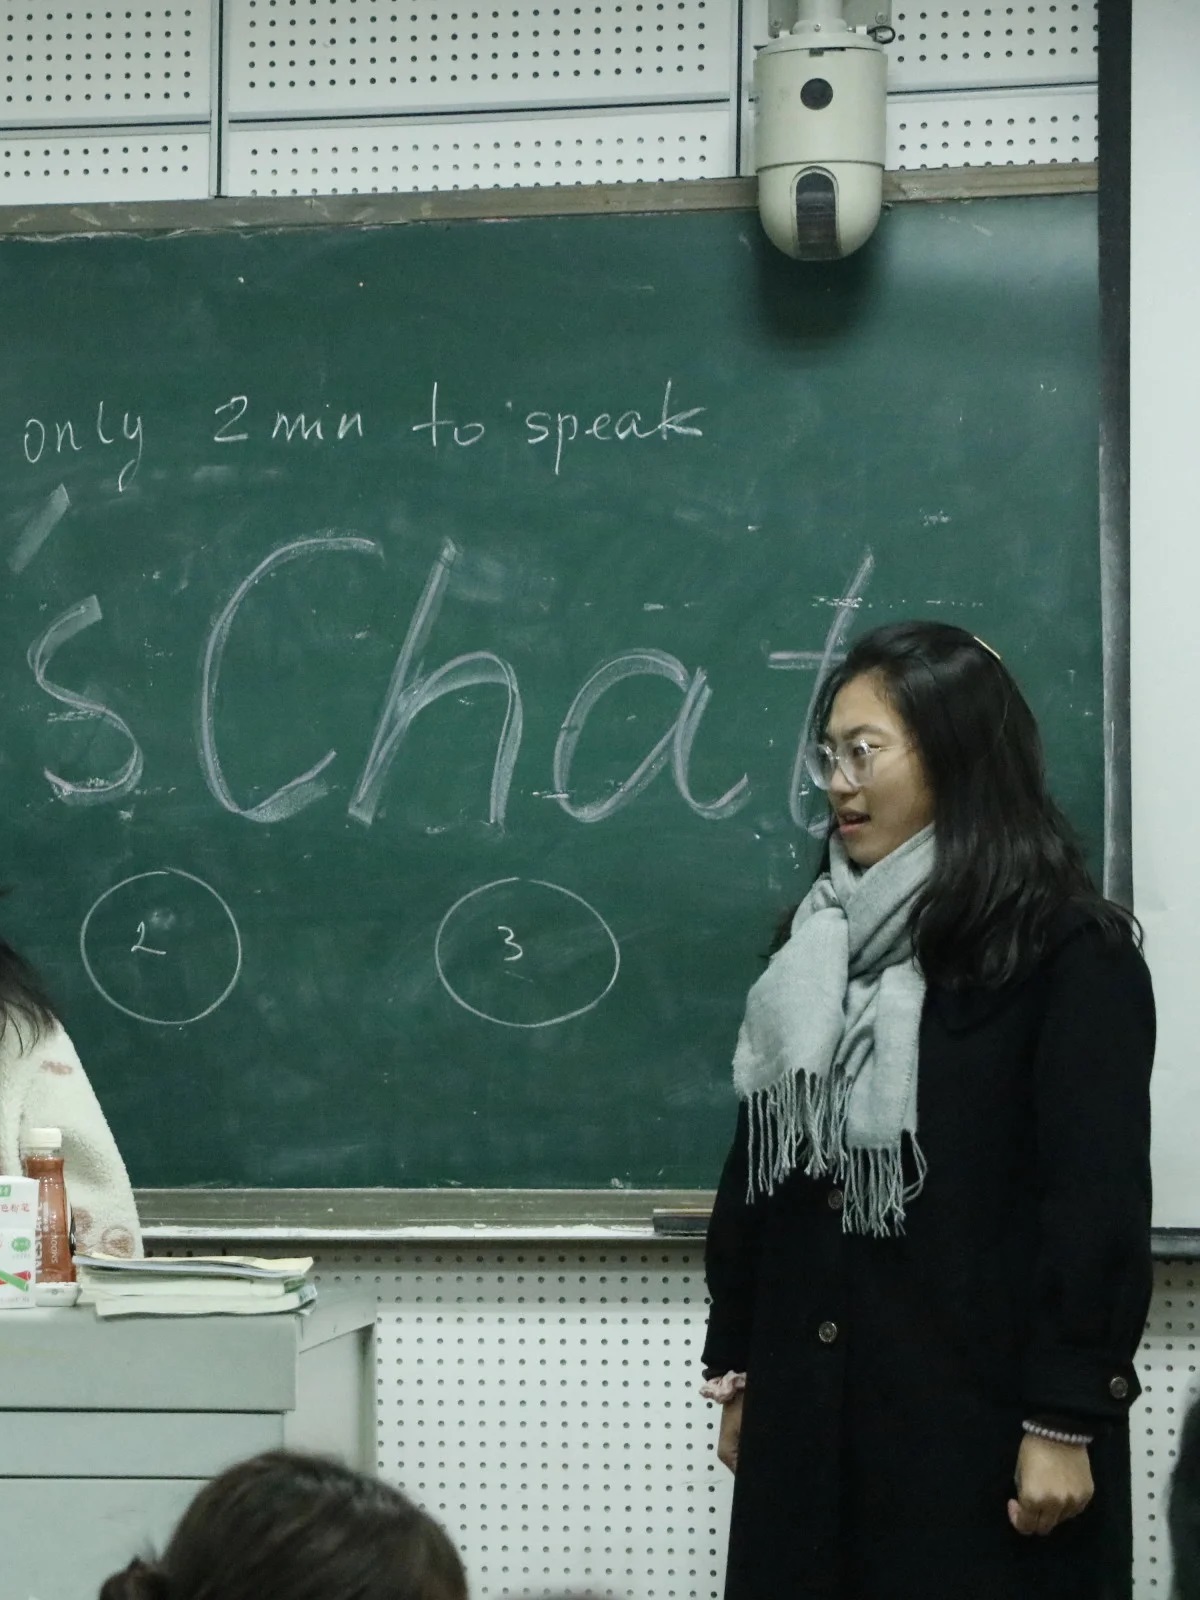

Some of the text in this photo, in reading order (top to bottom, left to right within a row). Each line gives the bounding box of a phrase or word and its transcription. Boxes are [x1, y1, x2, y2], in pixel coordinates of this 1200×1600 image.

[23, 378, 706, 492] only 2 min to speak
[195, 530, 873, 838] Chat
[130, 920, 167, 956] 2
[497, 925, 524, 962] 3
